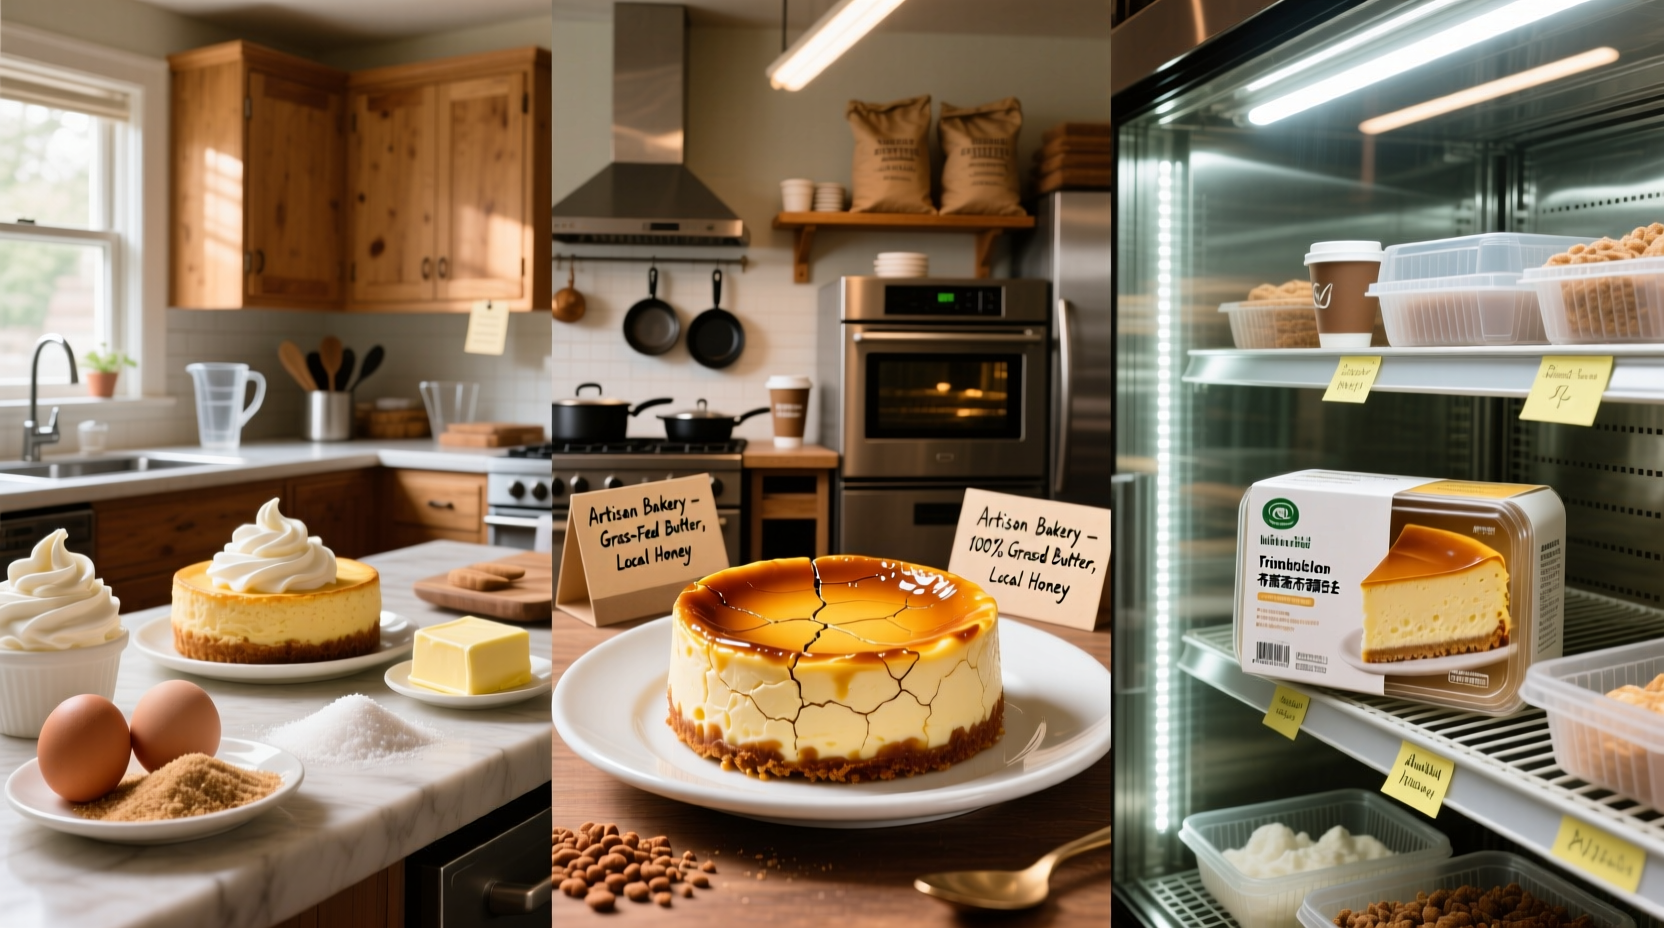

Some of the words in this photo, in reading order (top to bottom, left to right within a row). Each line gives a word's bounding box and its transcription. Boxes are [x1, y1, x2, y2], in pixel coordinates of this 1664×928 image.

[589, 506, 638, 527] Artisan
[643, 495, 686, 517] Bakery
[969, 535, 1004, 558] 100%
[1035, 517, 1081, 548] Bakery
[616, 548, 649, 571] Local
[655, 545, 692, 566] Honey
[989, 566, 1024, 587] Local
[1028, 572, 1070, 604] Honey
